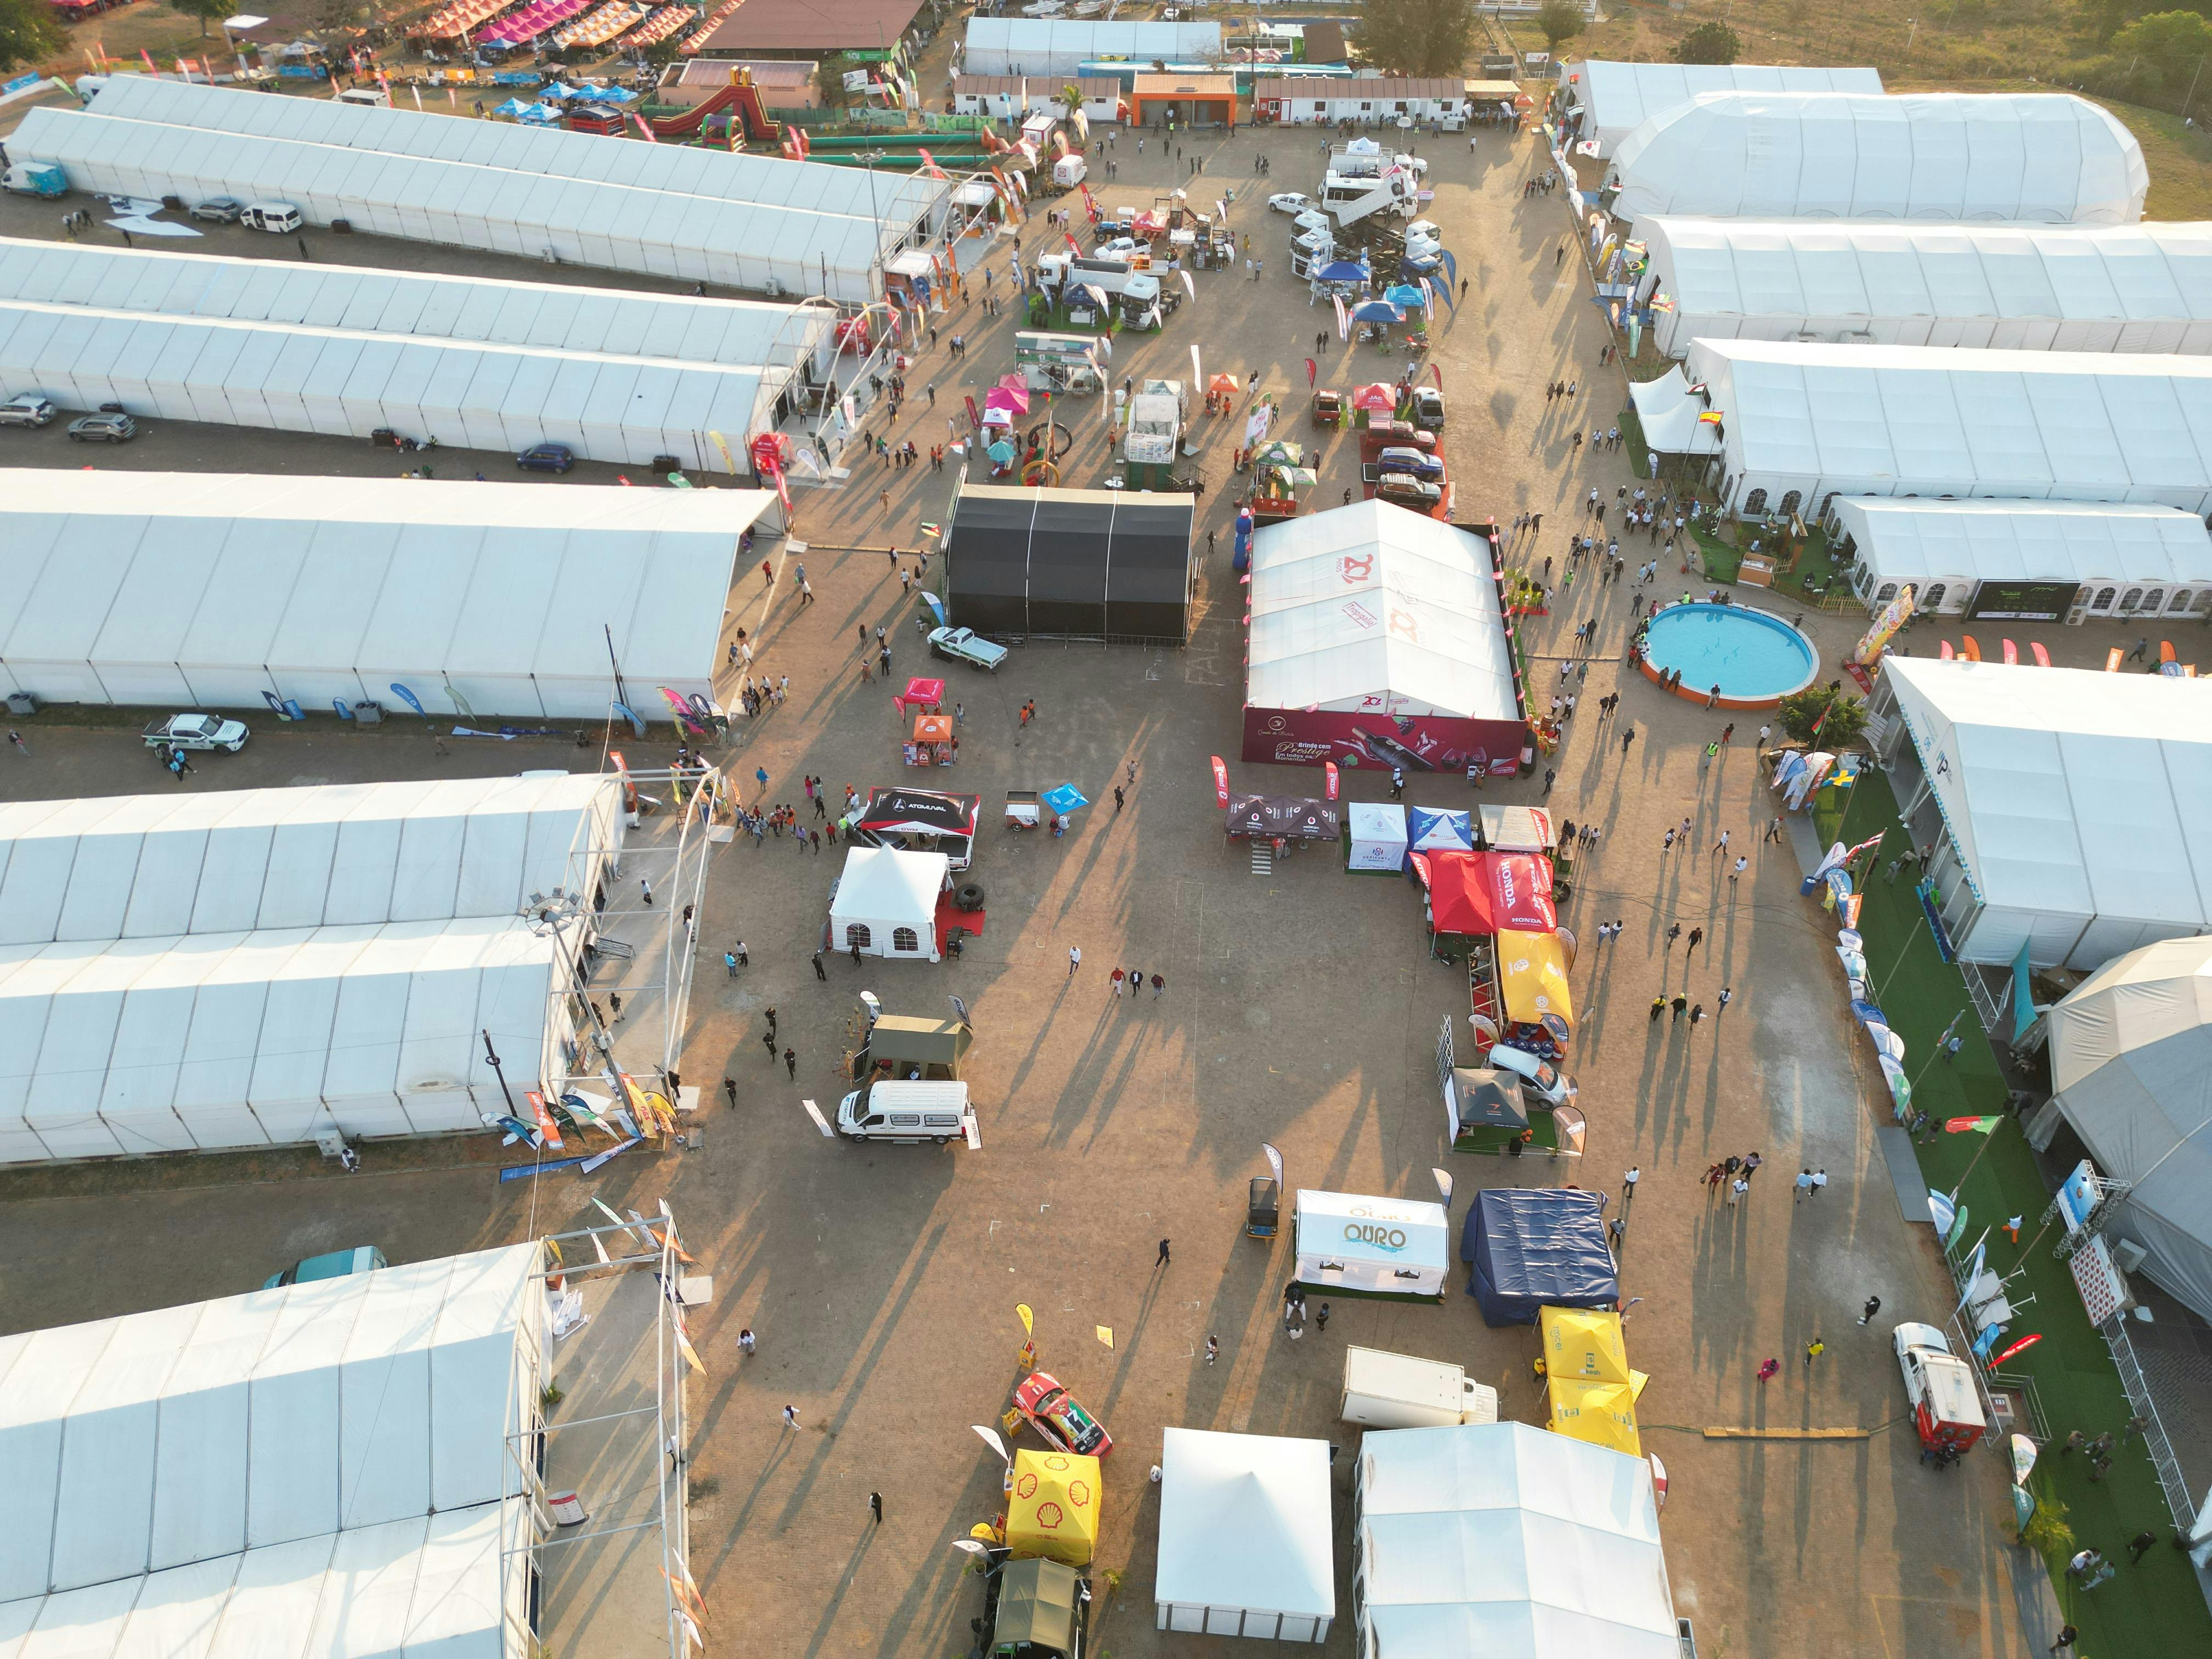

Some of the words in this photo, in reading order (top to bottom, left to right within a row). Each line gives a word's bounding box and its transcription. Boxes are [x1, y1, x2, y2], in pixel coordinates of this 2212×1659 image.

[1276, 742, 1330, 759] Prestige
[908, 803, 946, 812] ATOMUVAL
[1501, 860, 1516, 909] HONDA
[1344, 1223, 1406, 1248] OURO
